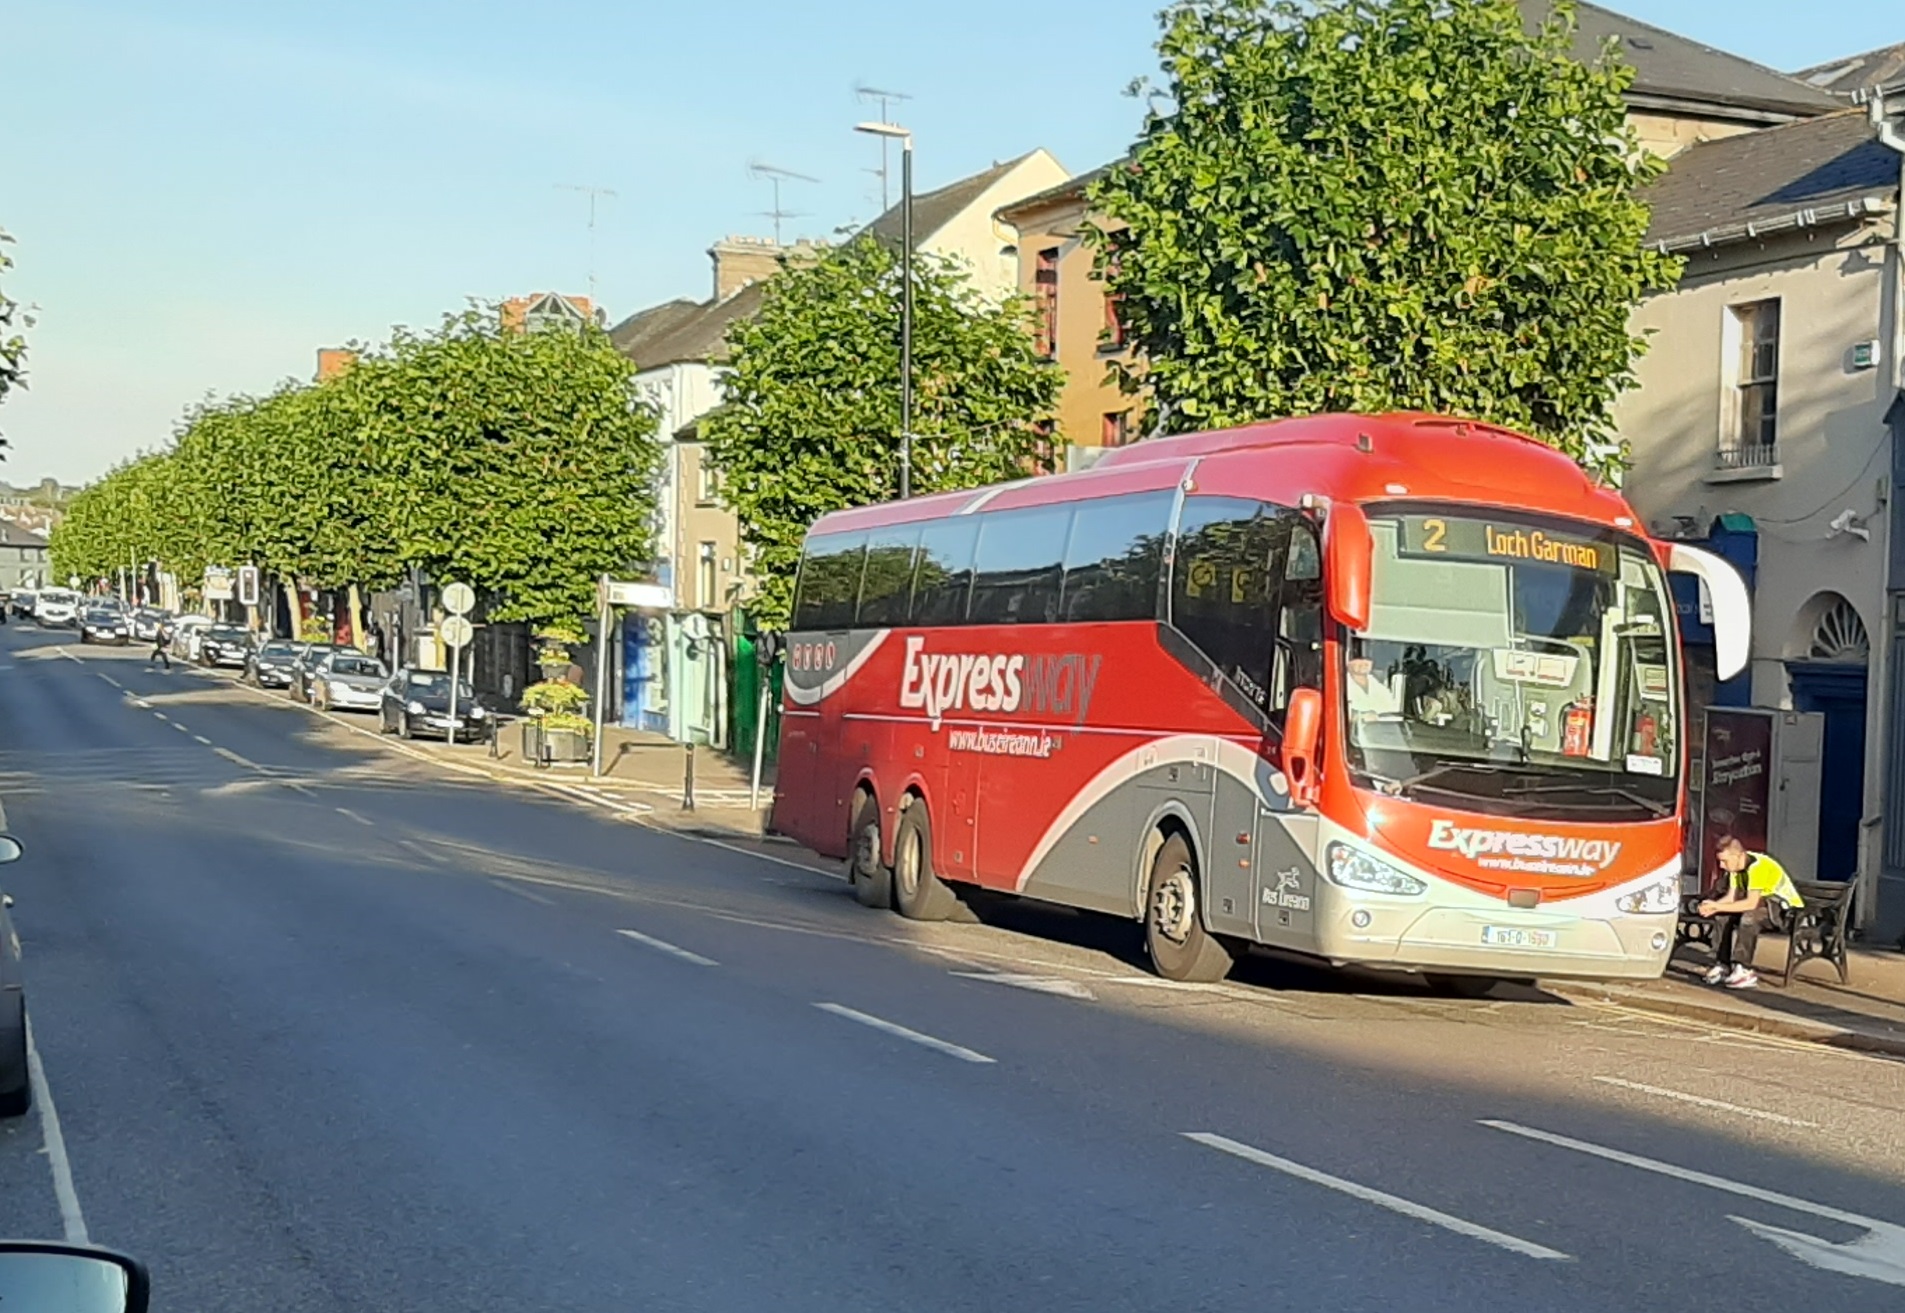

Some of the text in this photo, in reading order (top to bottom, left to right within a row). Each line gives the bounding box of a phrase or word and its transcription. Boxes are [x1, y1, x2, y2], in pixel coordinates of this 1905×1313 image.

[1423, 518, 1597, 569] 2 Loch Garman
[900, 635, 1102, 735] Expressway
[1427, 819, 1621, 869] Expressway
